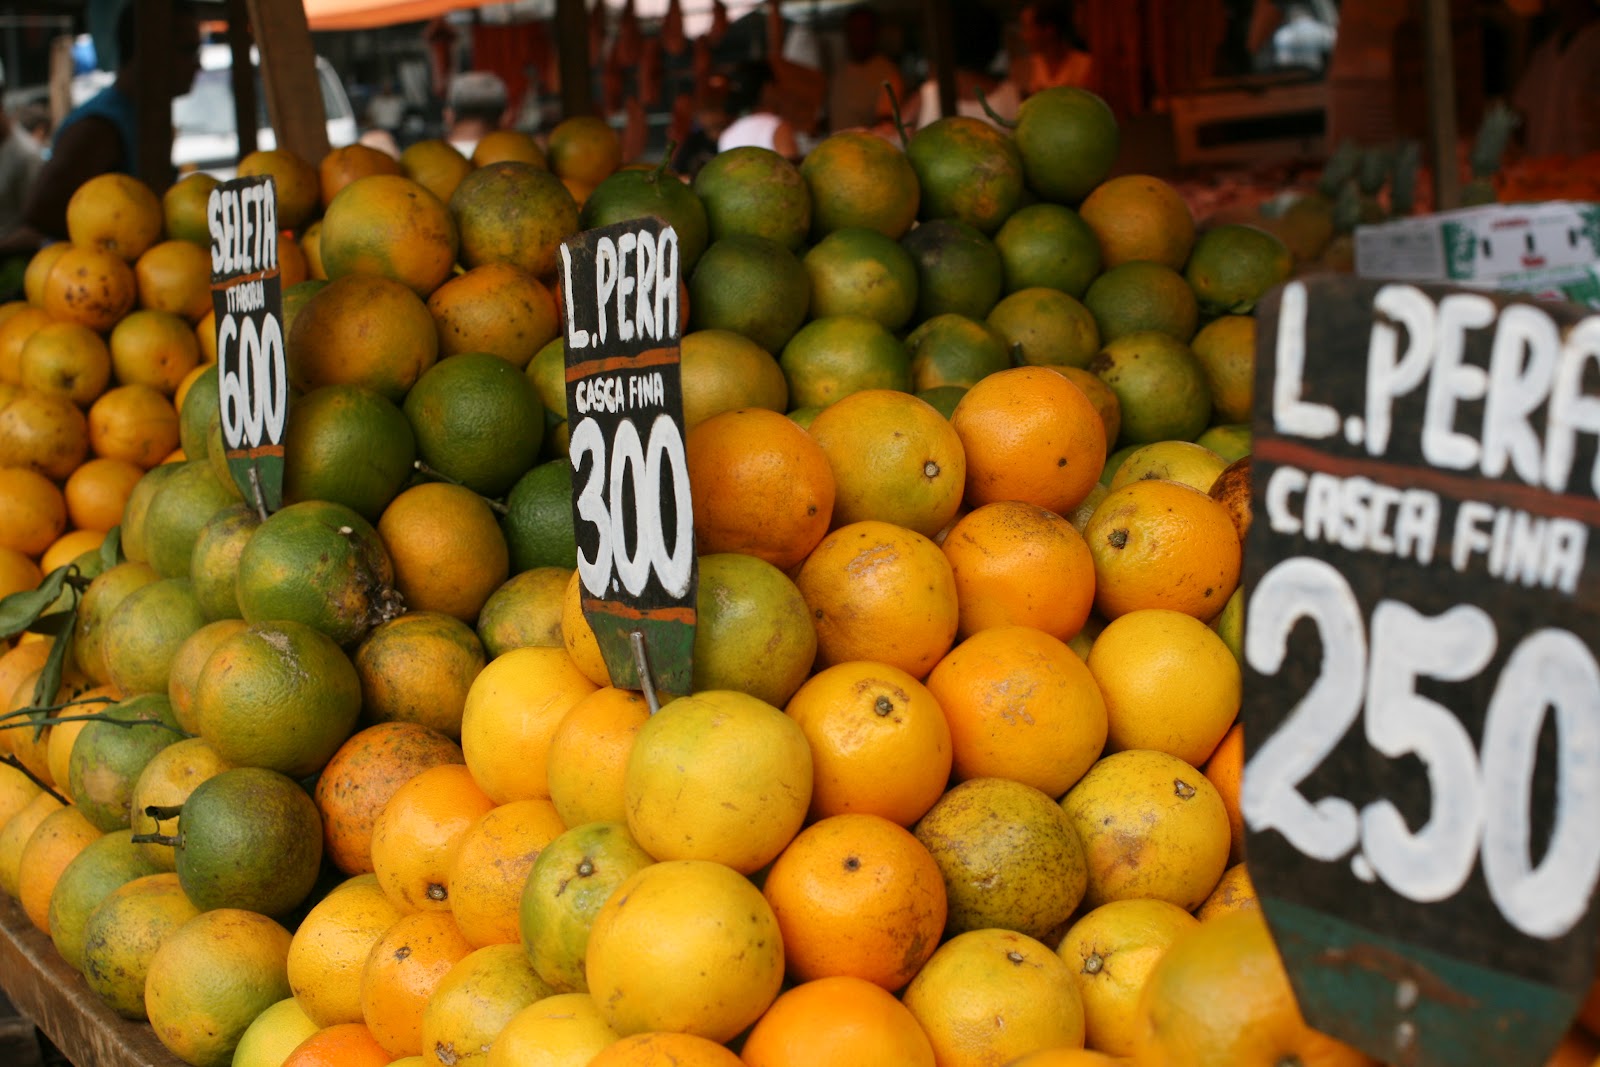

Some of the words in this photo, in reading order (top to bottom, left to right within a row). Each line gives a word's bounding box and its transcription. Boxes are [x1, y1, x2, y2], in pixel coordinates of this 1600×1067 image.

[207, 179, 277, 274] SELETA
[575, 375, 625, 414] CASCA
[628, 371, 665, 409] FINA
[570, 413, 694, 600] 3.00
[1265, 466, 1440, 566] CASCA
[1451, 501, 1587, 594] FINA
[1241, 557, 1600, 939] 2.50
